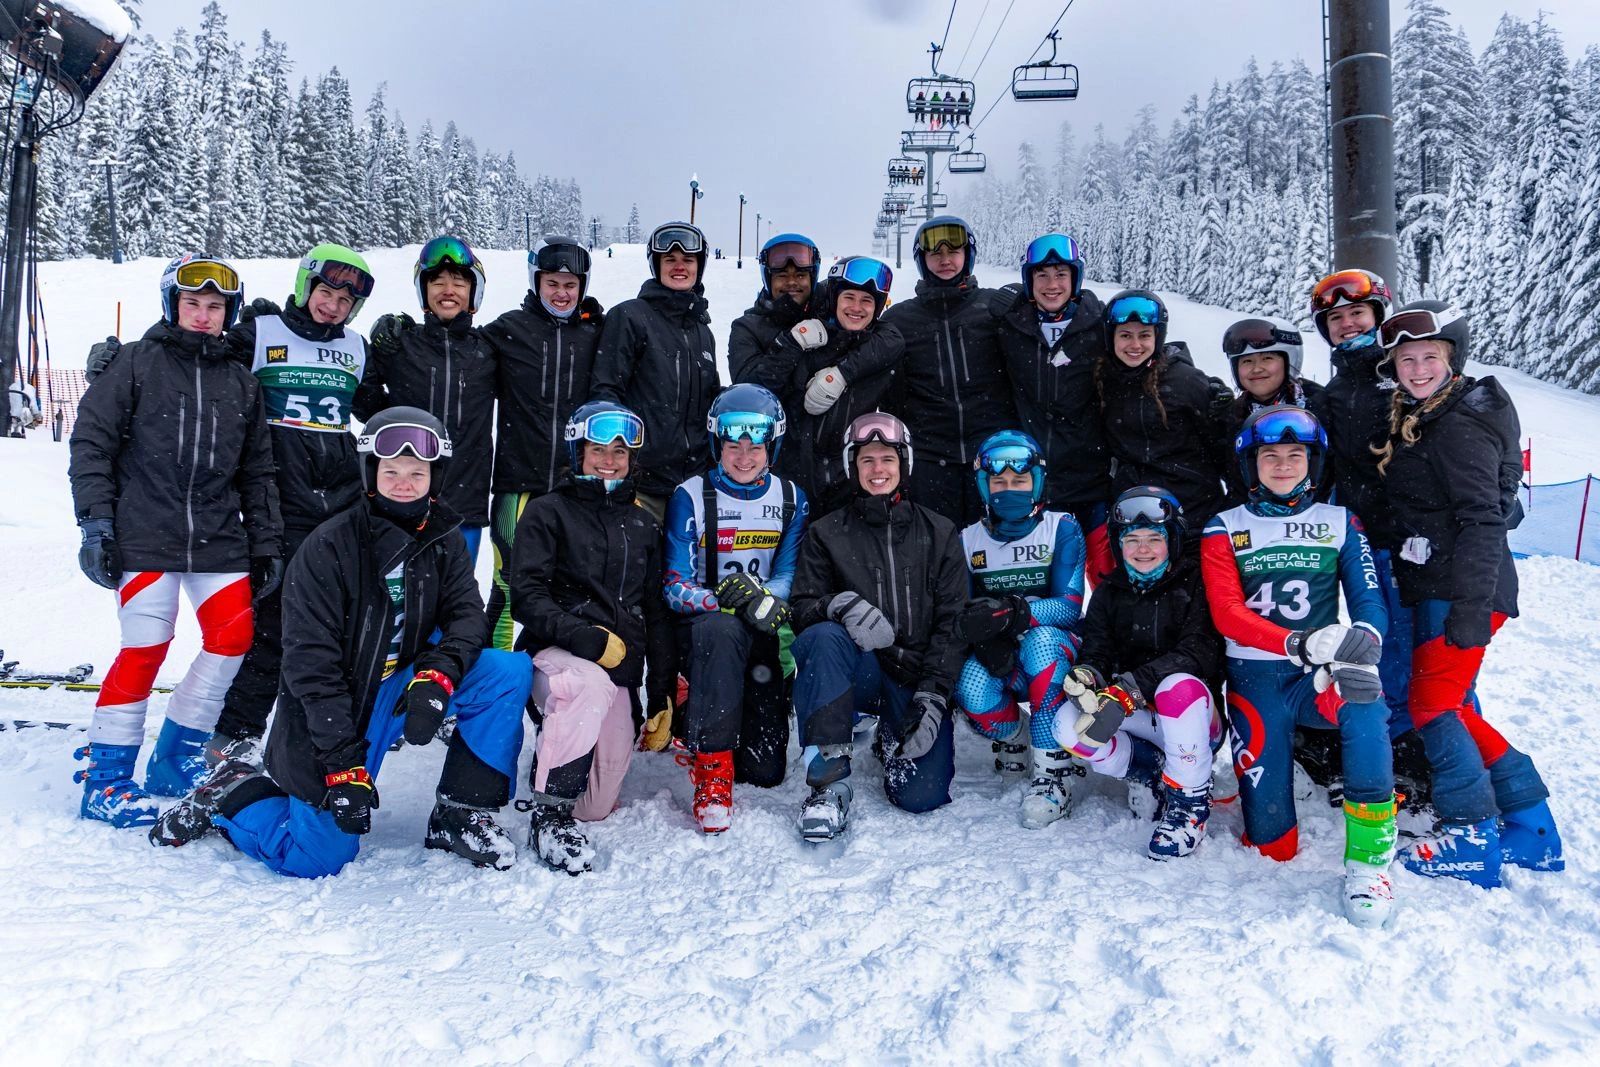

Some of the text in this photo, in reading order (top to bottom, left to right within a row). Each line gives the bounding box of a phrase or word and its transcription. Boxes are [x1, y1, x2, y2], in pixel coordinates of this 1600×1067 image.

[279, 371, 346, 382] EMERALD
[303, 379, 346, 389] LEAGUE
[283, 395, 342, 424] 53
[762, 505, 783, 519] PR
[717, 533, 734, 545] ires
[736, 535, 750, 545] LES
[1245, 553, 1320, 565] EMERALD
[1358, 532, 1379, 589] ARCTICA
[1245, 561, 1320, 572] SKI LEAGUE
[984, 572, 1045, 583] EMERALD
[1003, 578, 1046, 588] LEAGUE
[1245, 580, 1311, 620] 43
[1427, 861, 1485, 872] LANGE
